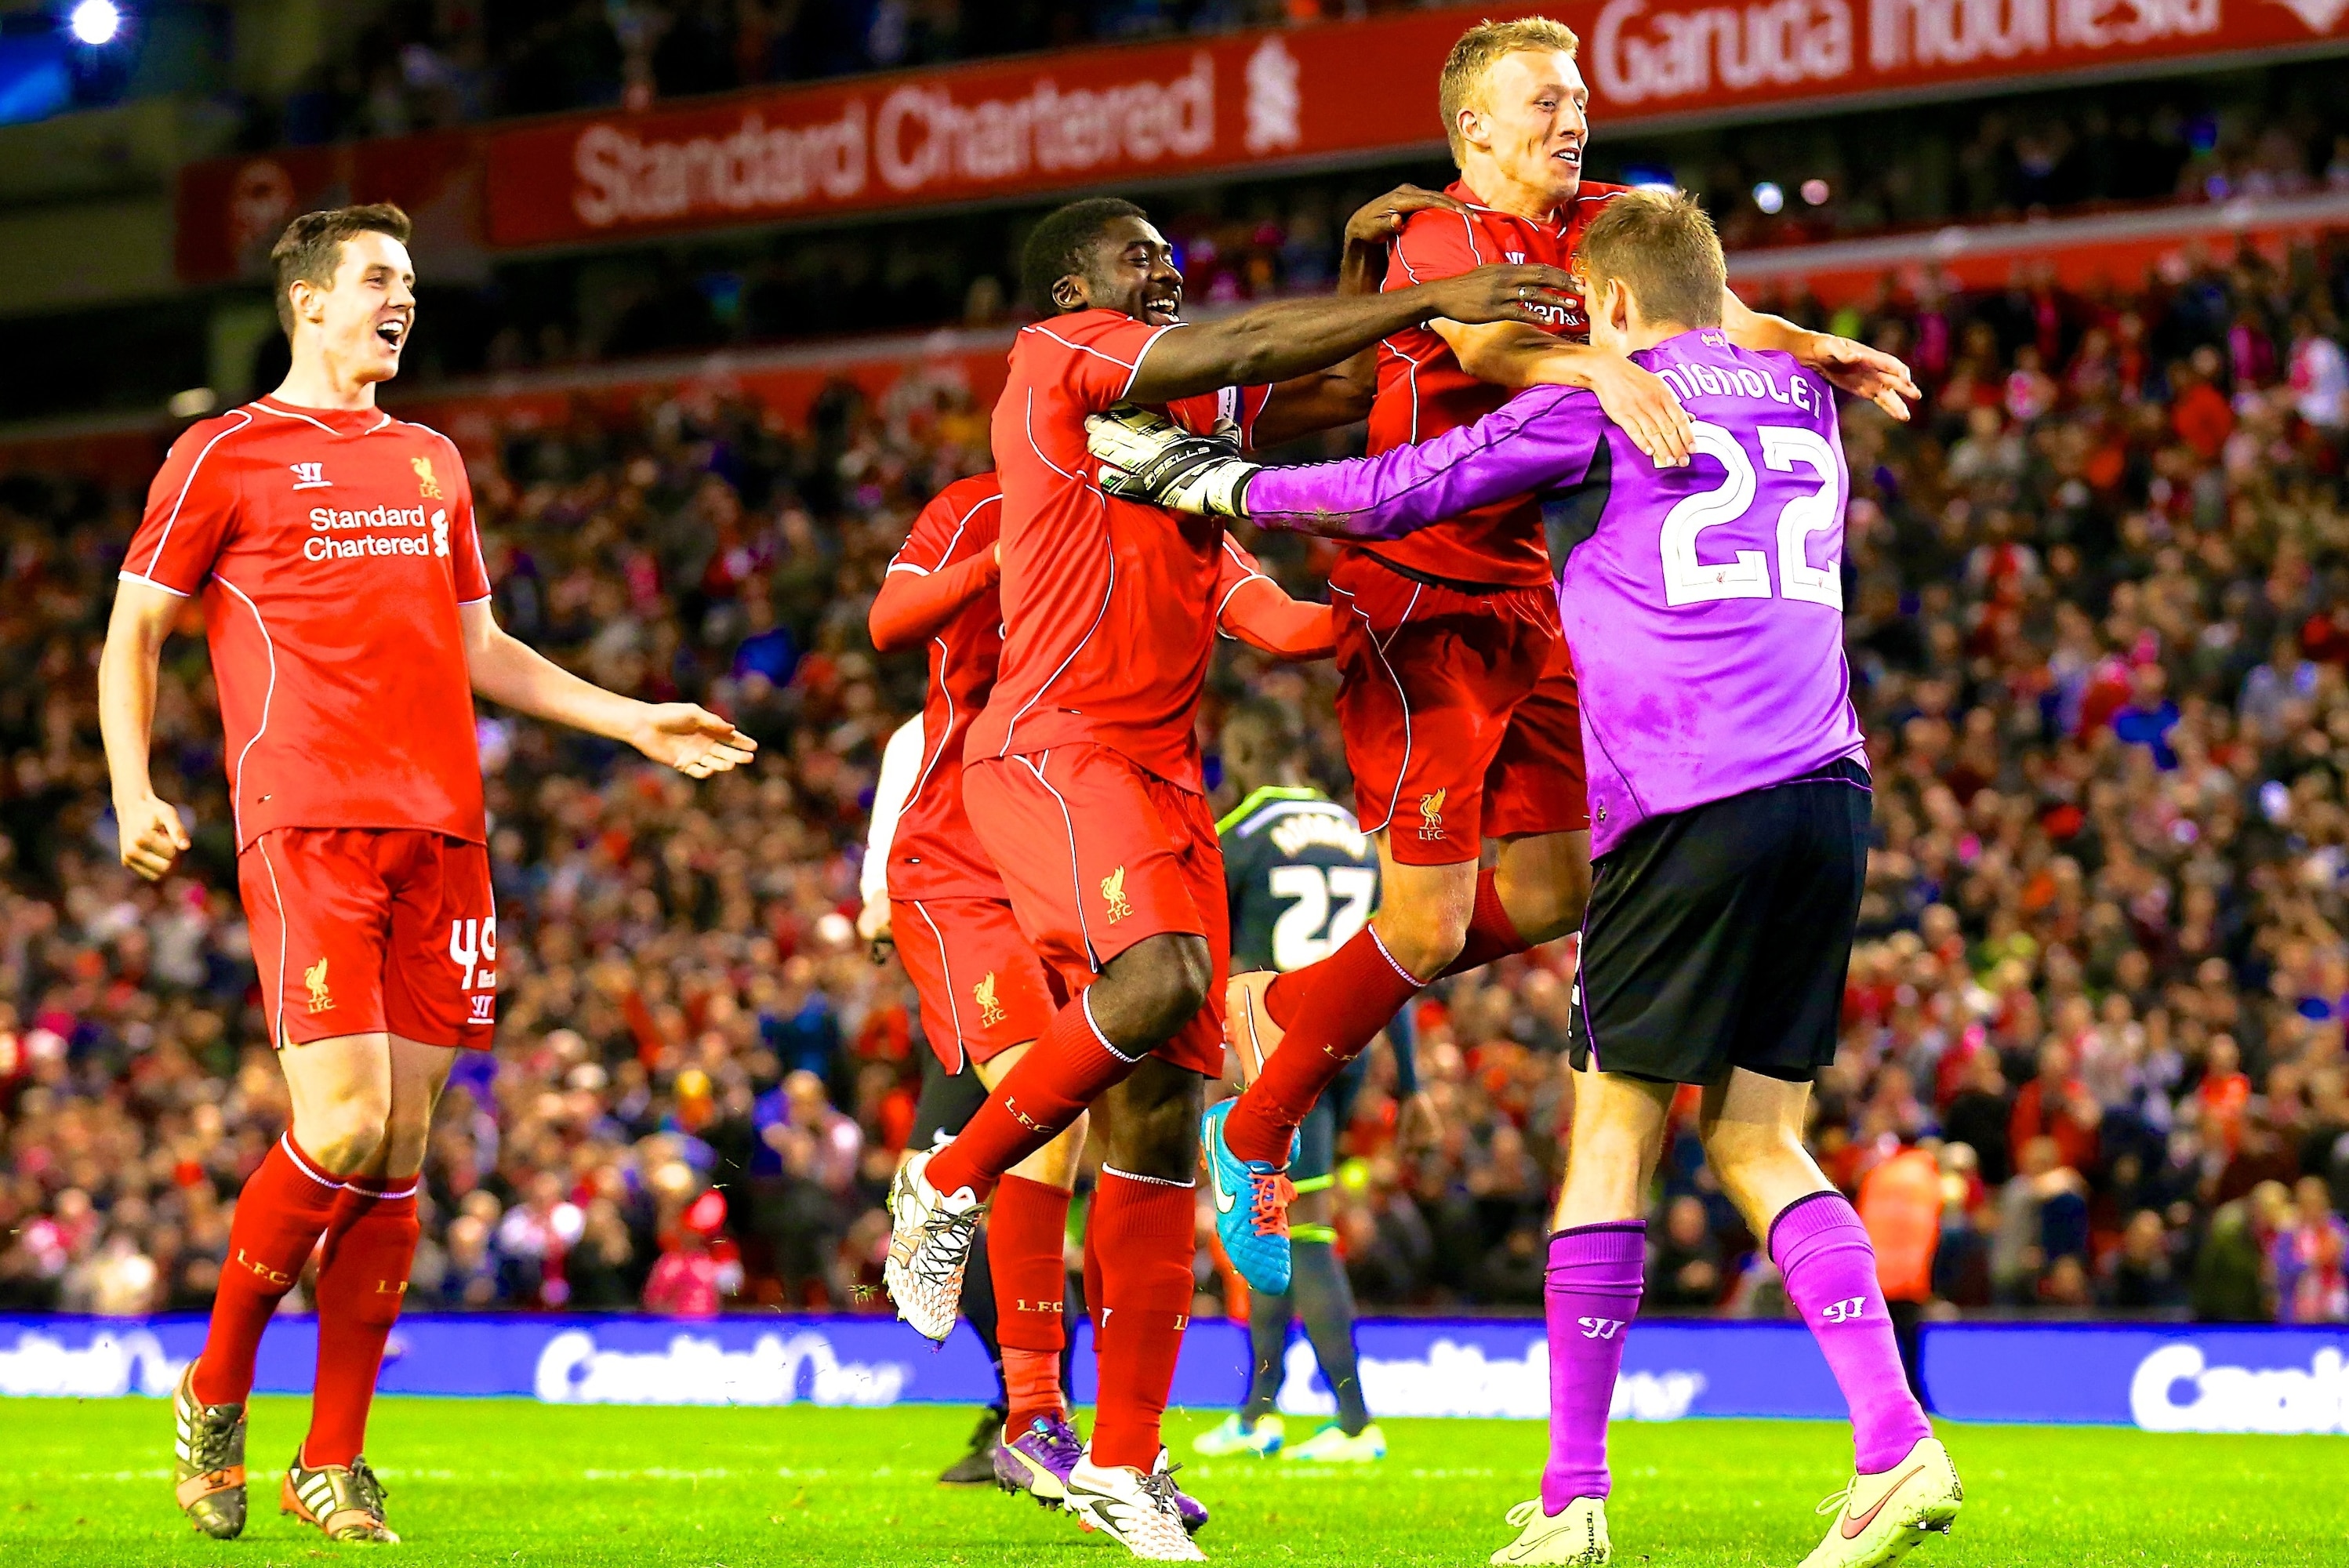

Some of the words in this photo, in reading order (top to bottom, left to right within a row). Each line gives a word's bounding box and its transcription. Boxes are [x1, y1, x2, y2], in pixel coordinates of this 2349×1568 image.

[1590, 0, 1854, 105] Garuda
[573, 100, 866, 227] Standard
[876, 53, 1214, 190] Chartered
[303, 532, 429, 562] Chartered
[309, 504, 426, 532] Standard
[1654, 419, 1843, 612] 22
[1269, 864, 1377, 972] 27
